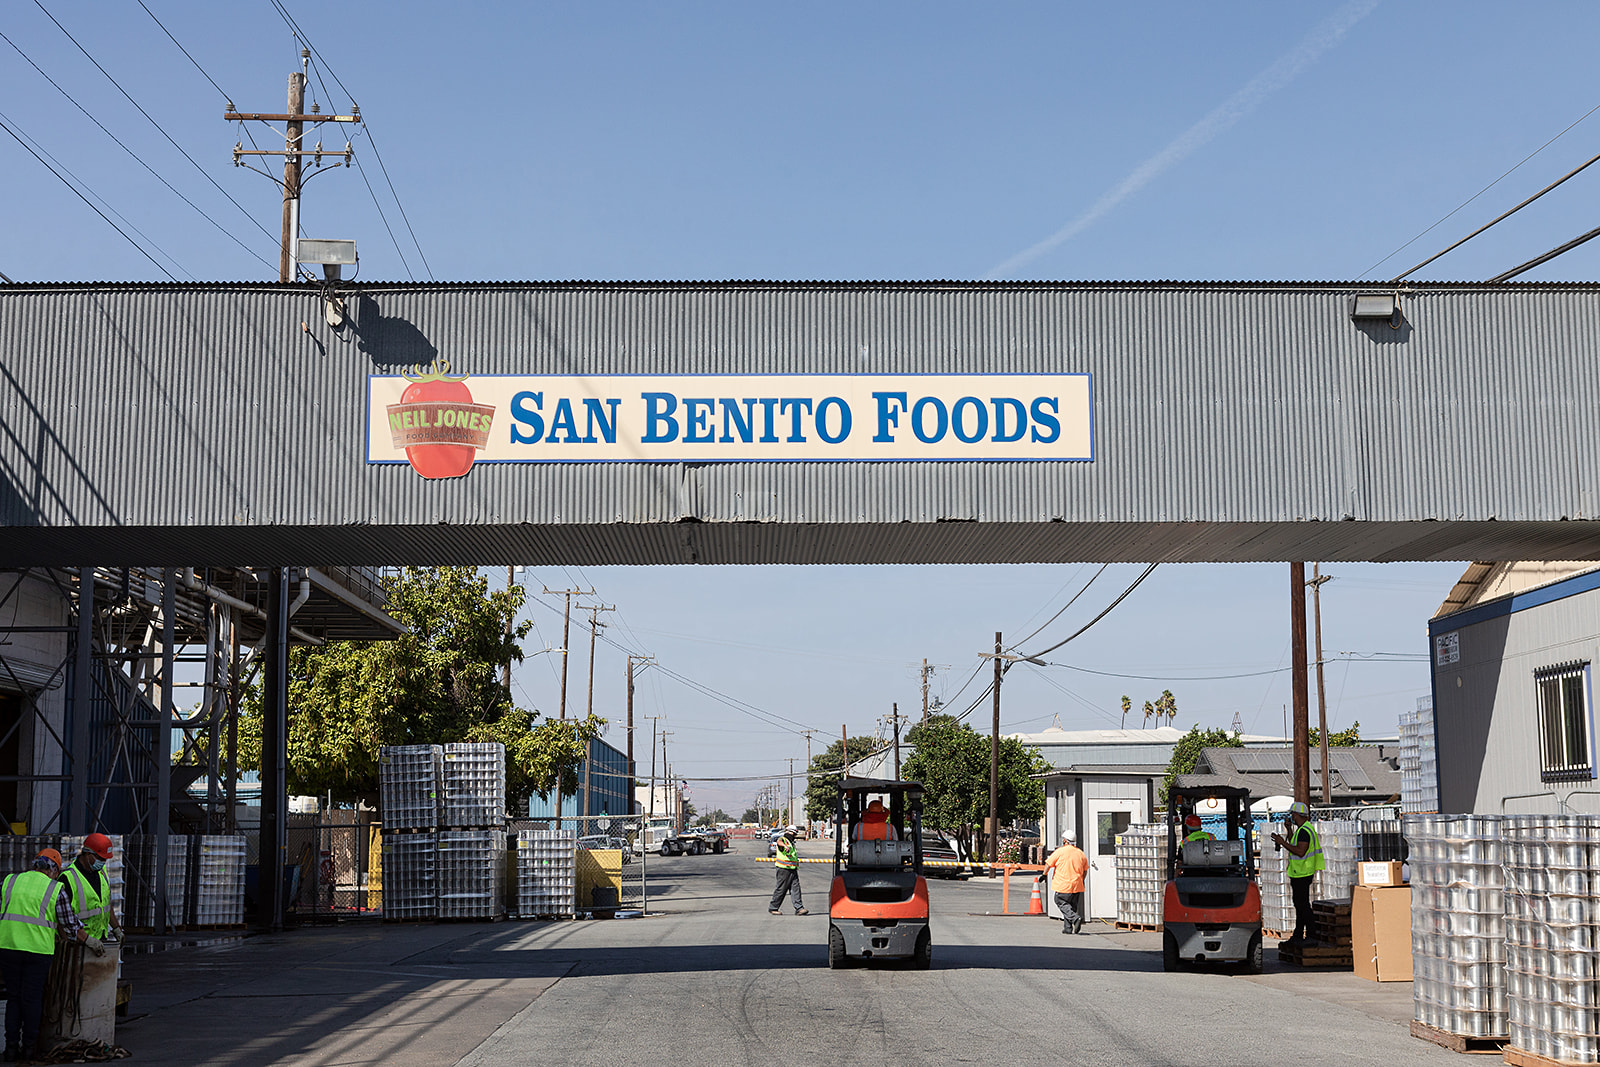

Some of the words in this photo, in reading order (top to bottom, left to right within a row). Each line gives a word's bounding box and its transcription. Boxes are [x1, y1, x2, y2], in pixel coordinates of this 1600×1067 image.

[389, 410, 430, 431] NEIL
[434, 409, 491, 432] JONES
[510, 391, 621, 444] SAN
[640, 392, 852, 444] BENITO
[872, 391, 1060, 444] FOODS
[433, 432, 474, 440] COMPANY
